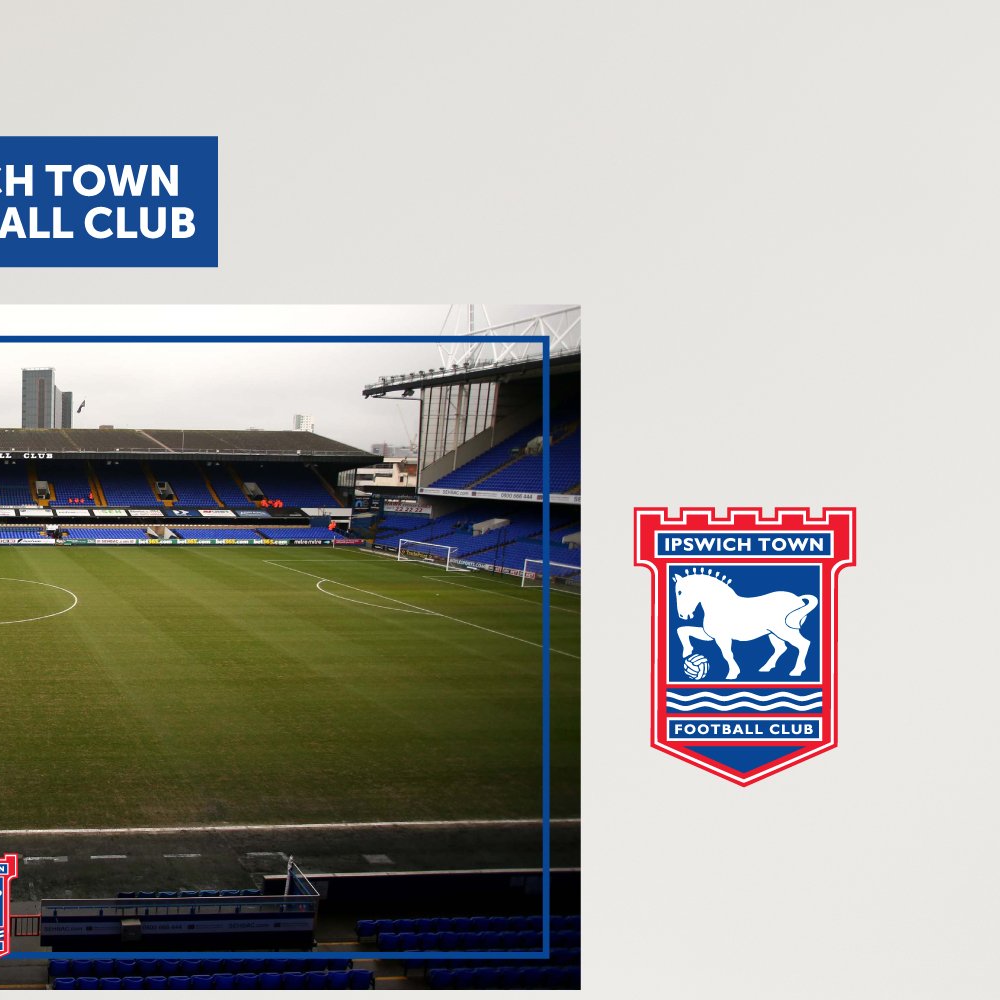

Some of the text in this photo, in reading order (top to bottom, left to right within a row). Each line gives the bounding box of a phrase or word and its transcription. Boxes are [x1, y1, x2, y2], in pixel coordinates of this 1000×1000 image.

[45, 164, 179, 197] TOWN
[84, 206, 196, 239] CLUB
[665, 537, 824, 552] IPSWICH TOWN
[674, 723, 814, 735] FOOTBALL CLUB
